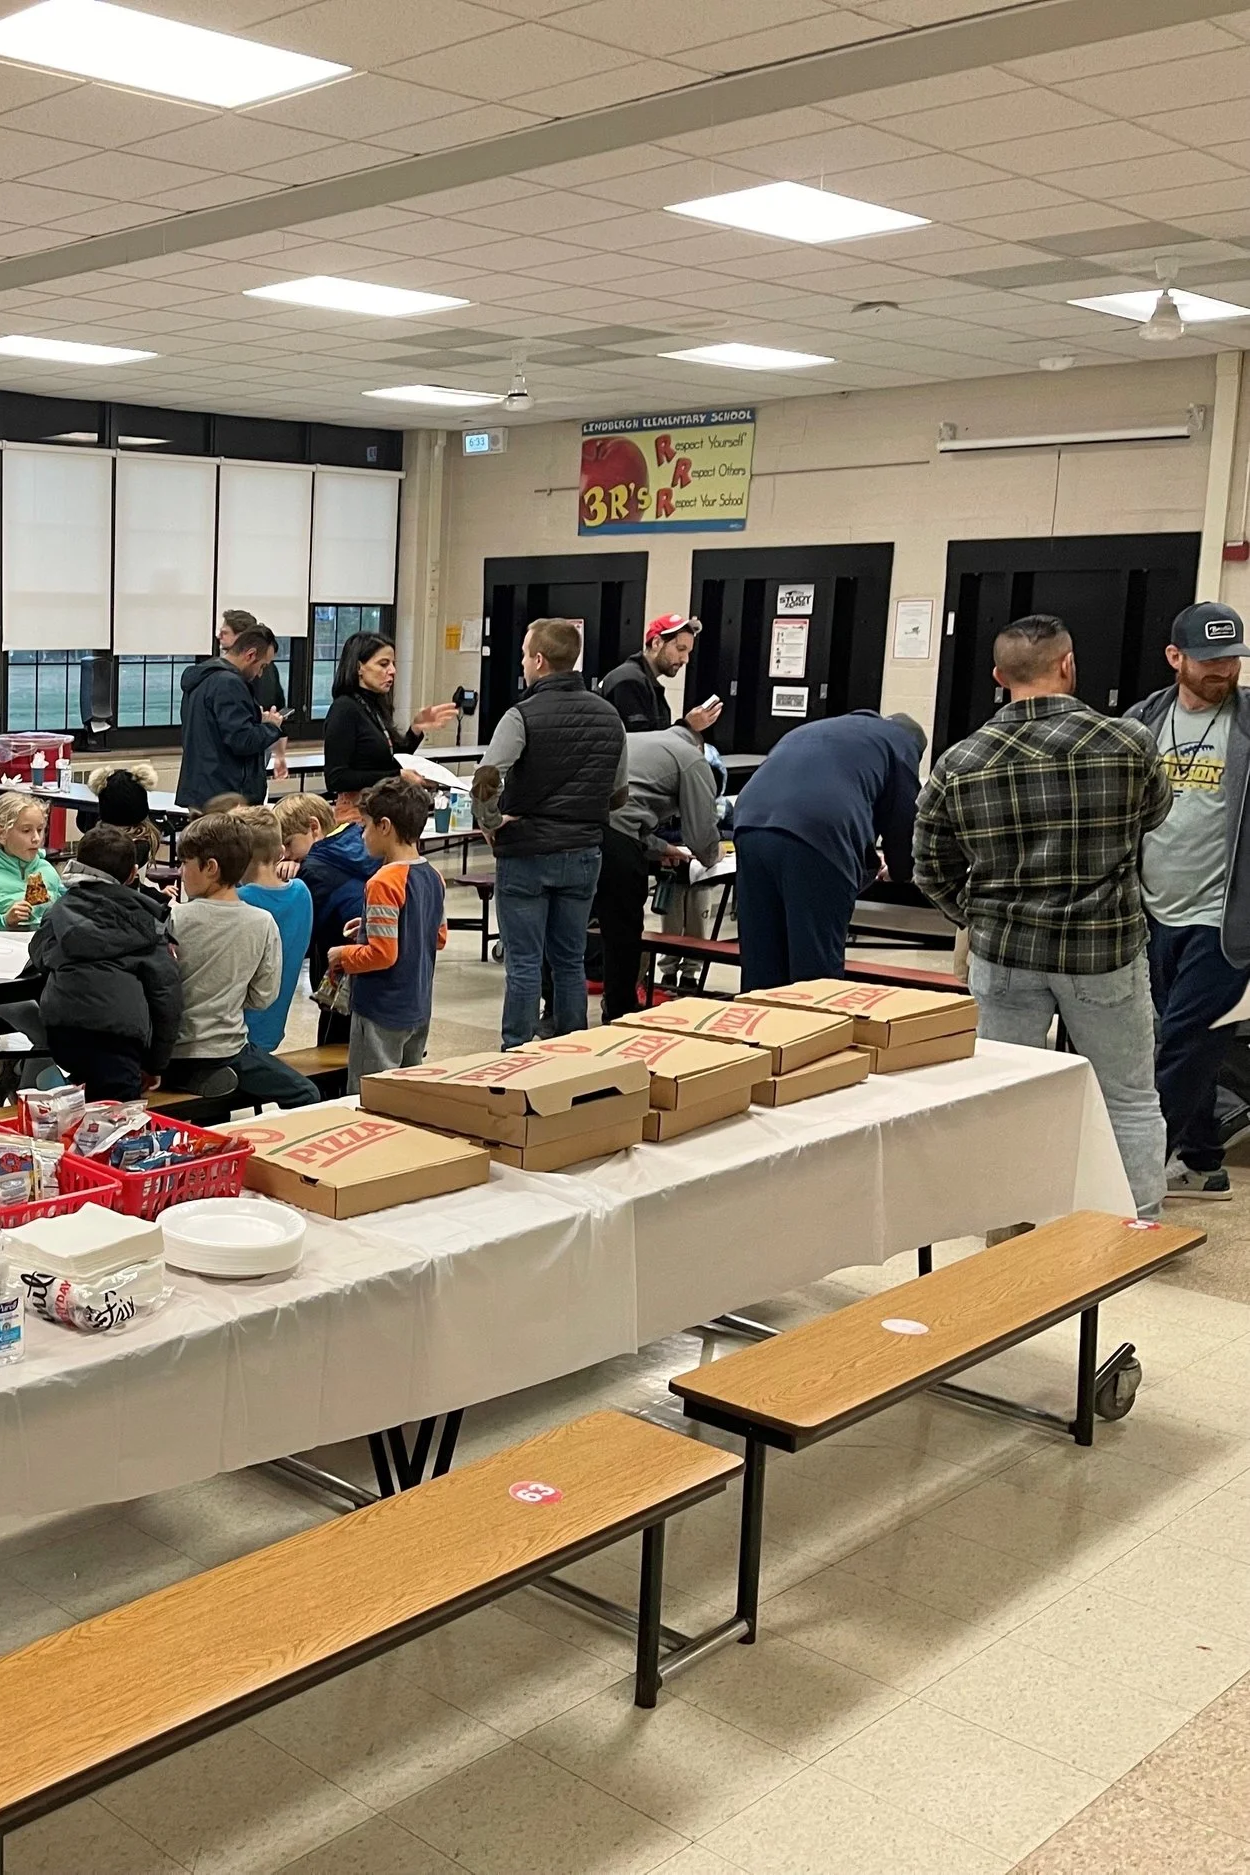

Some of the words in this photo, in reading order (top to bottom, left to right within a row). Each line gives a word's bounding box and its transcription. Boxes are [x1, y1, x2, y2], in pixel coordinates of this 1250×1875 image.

[642, 412, 706, 428] ELEMENTARY
[711, 410, 752, 422] SCHOOL
[718, 462, 746, 477] Others
[700, 494, 717, 507] Your
[719, 492, 744, 507] School
[827, 988, 889, 1009] PIZZA
[708, 1007, 759, 1034] PIZZA
[456, 1056, 546, 1081] PIZZA
[282, 1121, 398, 1164] PIZZA
[516, 1483, 556, 1502] 63
